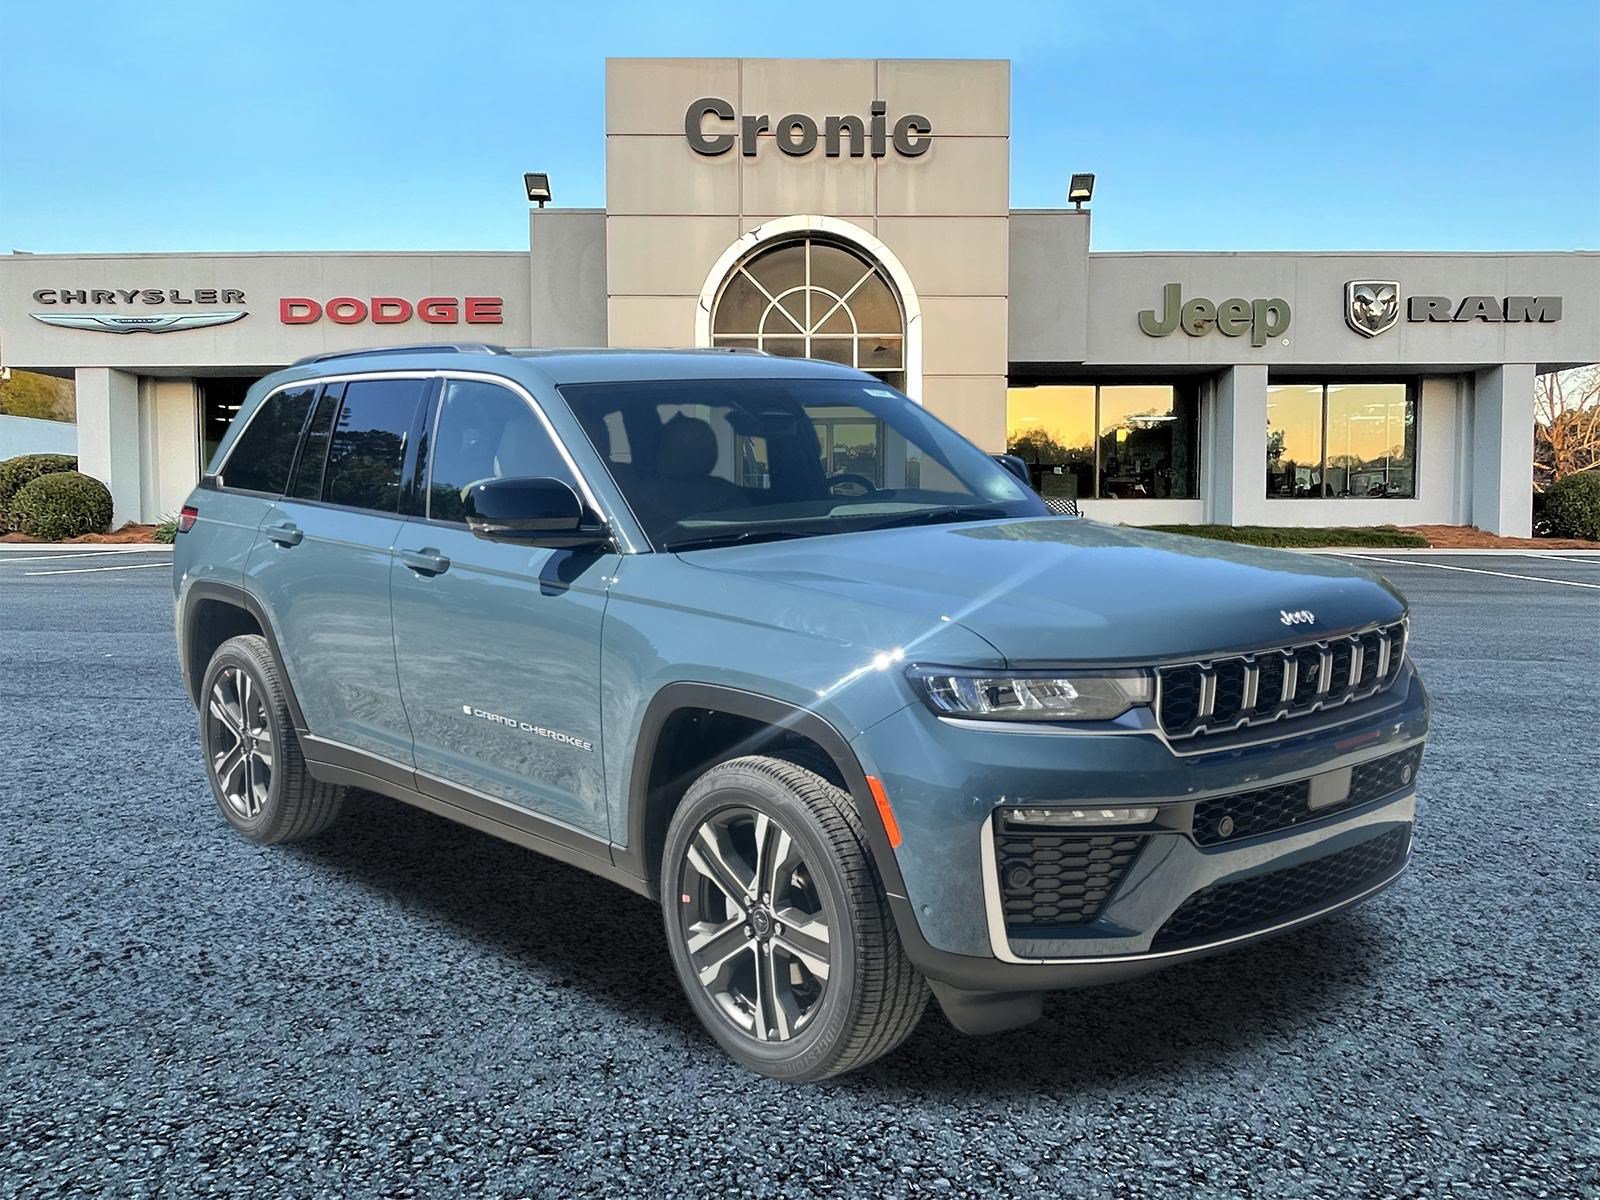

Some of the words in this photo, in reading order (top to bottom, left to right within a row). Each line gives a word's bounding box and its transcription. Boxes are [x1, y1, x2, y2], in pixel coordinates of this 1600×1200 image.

[684, 97, 932, 158] Cronic
[32, 289, 247, 305] CHRYSLER
[279, 296, 504, 325] DODGE
[1407, 296, 1563, 323] RAM
[1138, 283, 1291, 347] Jeep
[1280, 609, 1315, 626] Jeep
[473, 708, 519, 728] GRAND
[520, 722, 593, 752] CHEROKEE
